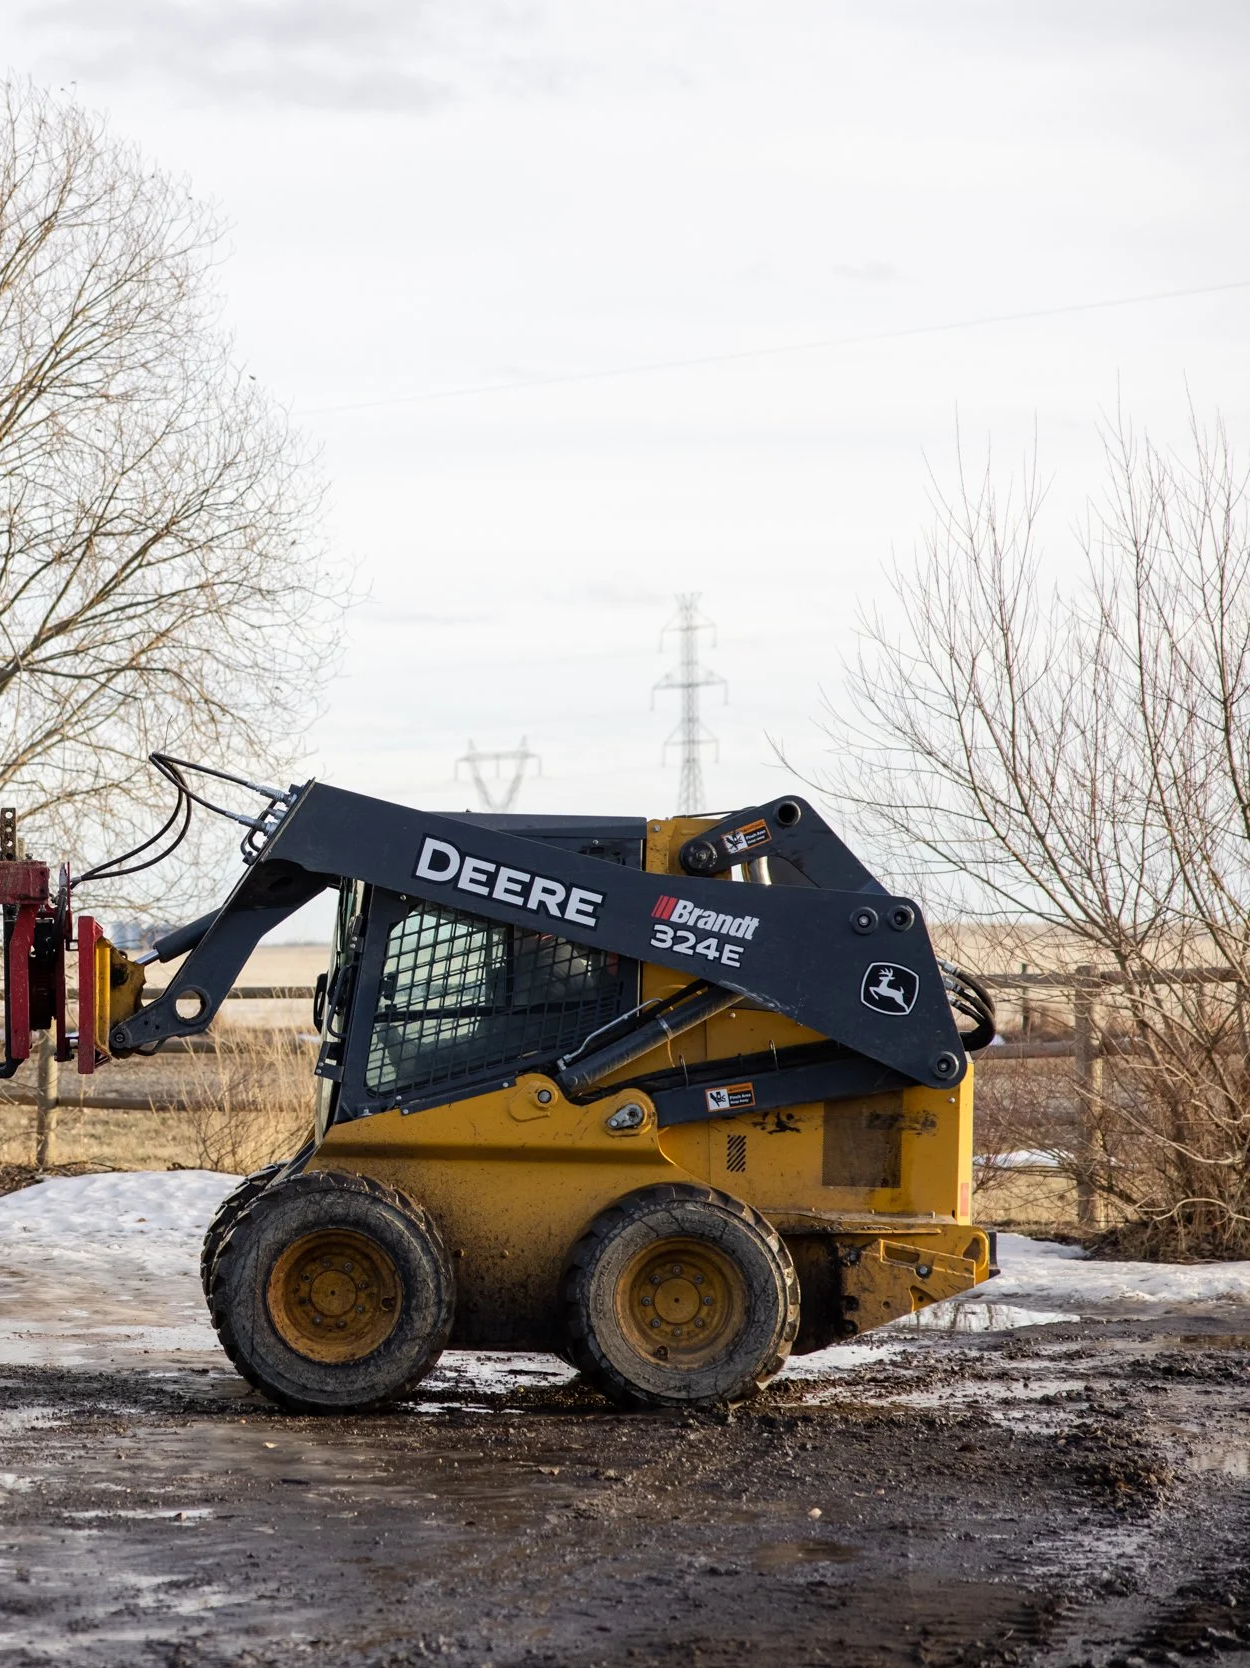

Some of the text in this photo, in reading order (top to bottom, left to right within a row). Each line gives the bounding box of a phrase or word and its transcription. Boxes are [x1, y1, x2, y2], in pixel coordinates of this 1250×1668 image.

[415, 837, 604, 927] DEERE
[670, 899, 760, 940] Brandt
[650, 924, 745, 968] 324E
